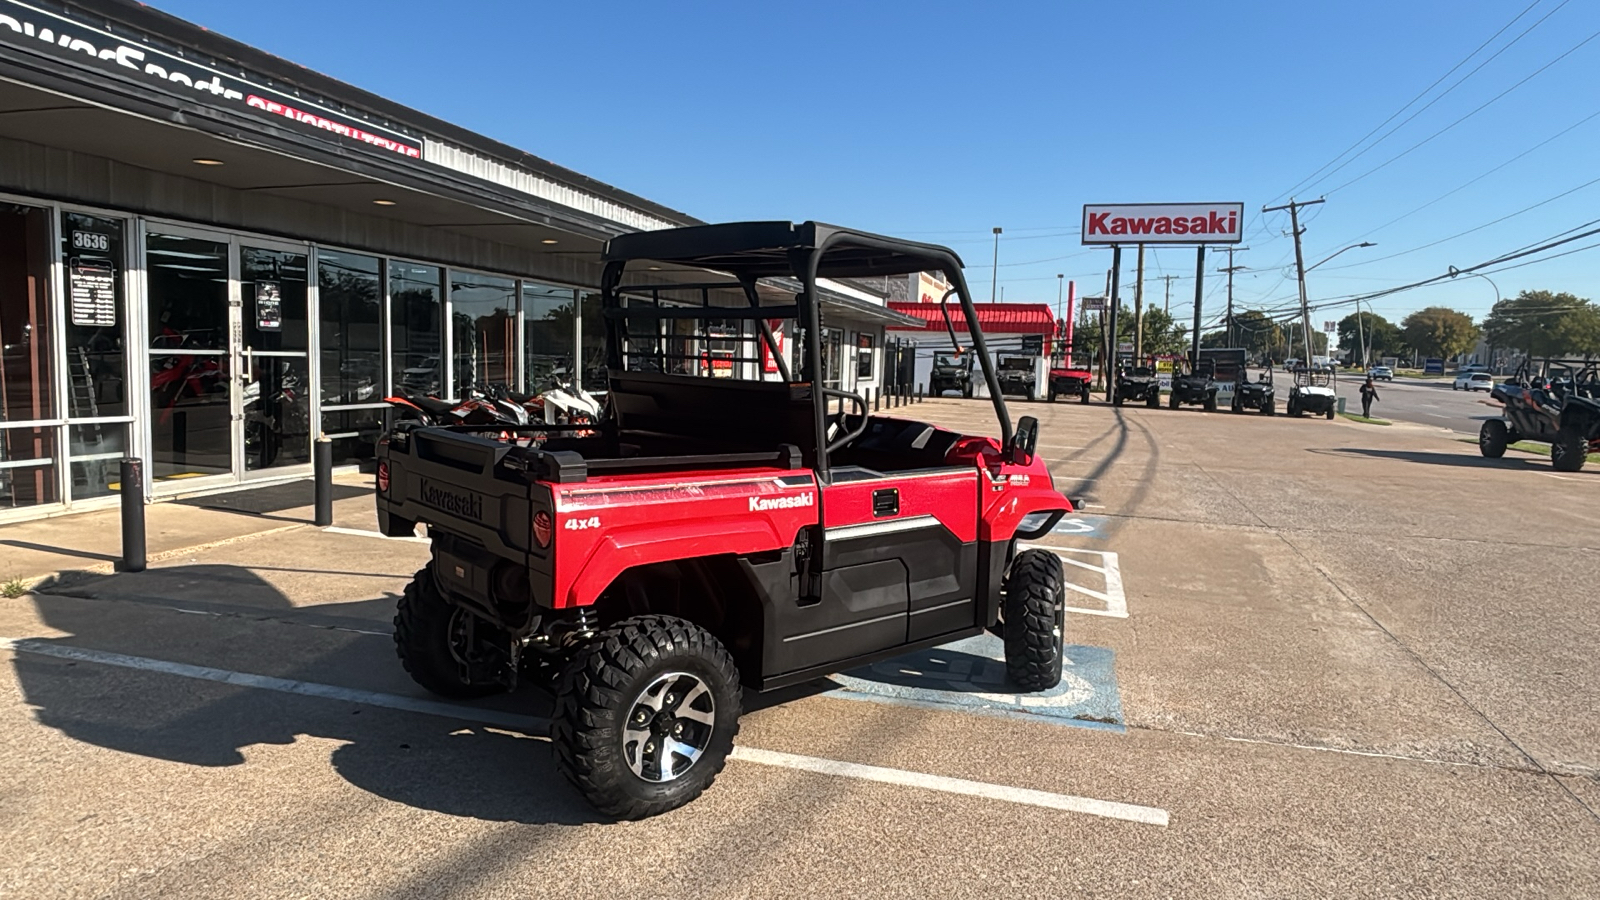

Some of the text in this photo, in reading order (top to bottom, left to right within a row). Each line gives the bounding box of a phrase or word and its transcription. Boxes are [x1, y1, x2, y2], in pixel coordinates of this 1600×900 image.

[1088, 211, 1237, 235] Kawasaki
[75, 233, 107, 250] 3636
[421, 477, 482, 520] Kawasaki
[748, 491, 814, 511] Kawasaki
[564, 516, 601, 531] 4x4
